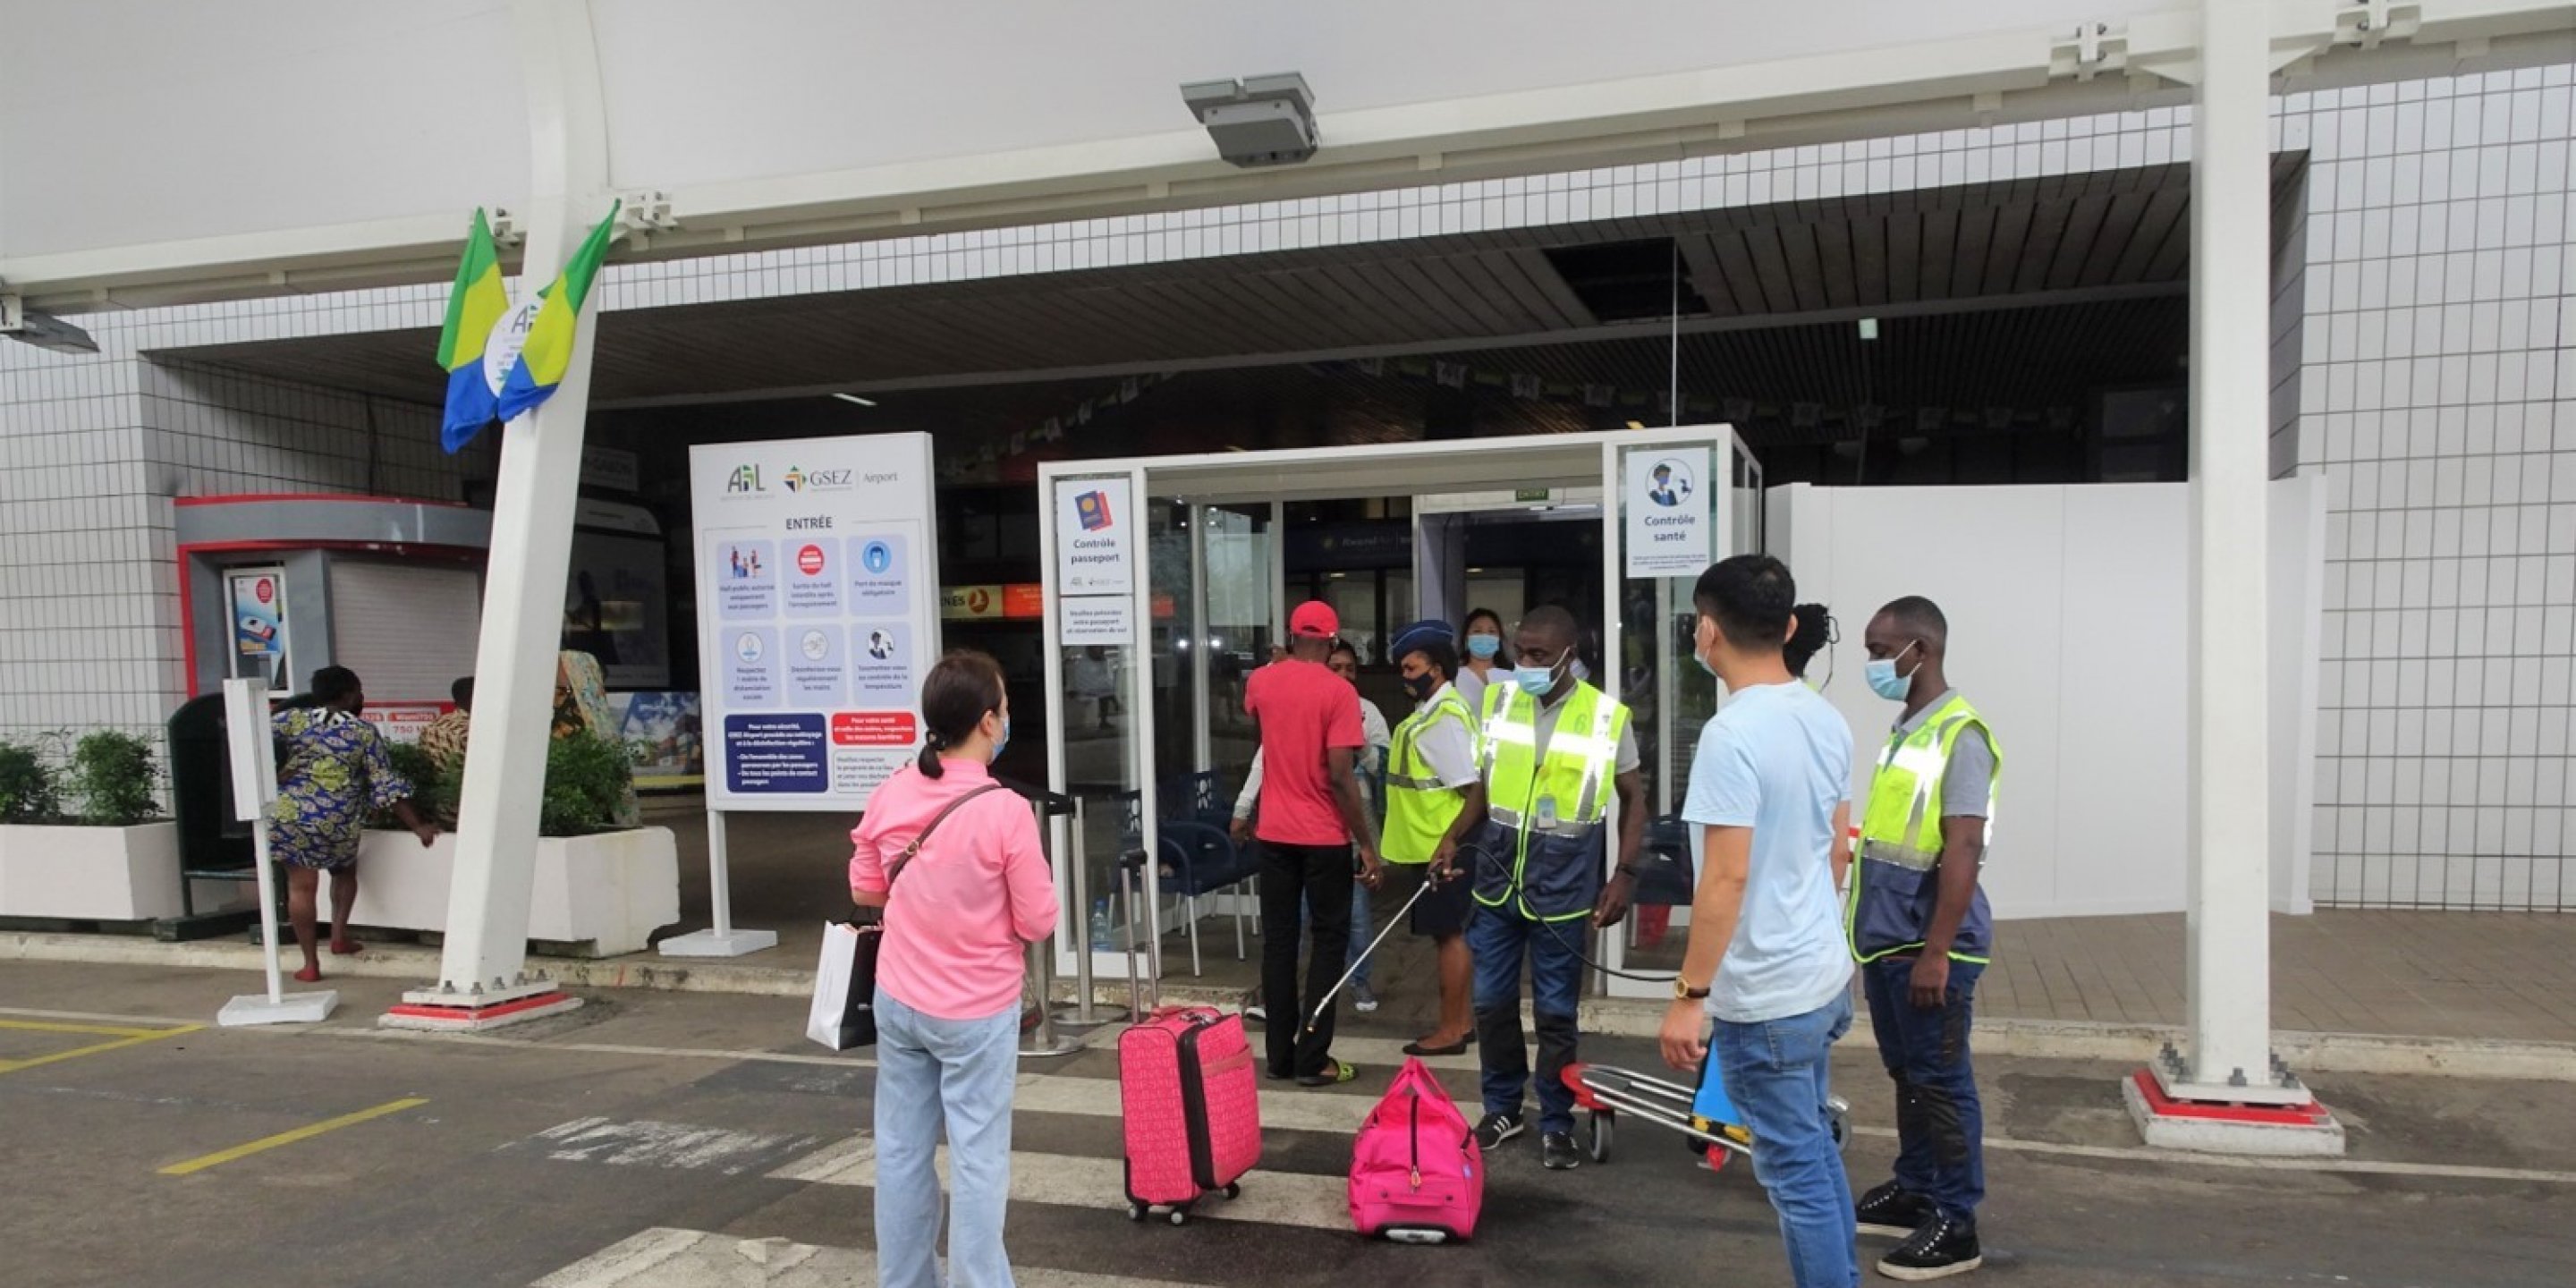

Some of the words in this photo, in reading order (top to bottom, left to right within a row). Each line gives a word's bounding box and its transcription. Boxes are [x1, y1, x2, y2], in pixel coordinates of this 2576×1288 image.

[809, 470, 852, 487] GSEZ
[863, 471, 897, 484] Airport
[786, 516, 833, 530] ENTRÉE
[1644, 514, 1696, 527] Contrôle
[1653, 530, 1686, 542] santé
[1073, 538, 1115, 549] Contrôle
[1071, 553, 1120, 566] passeport
